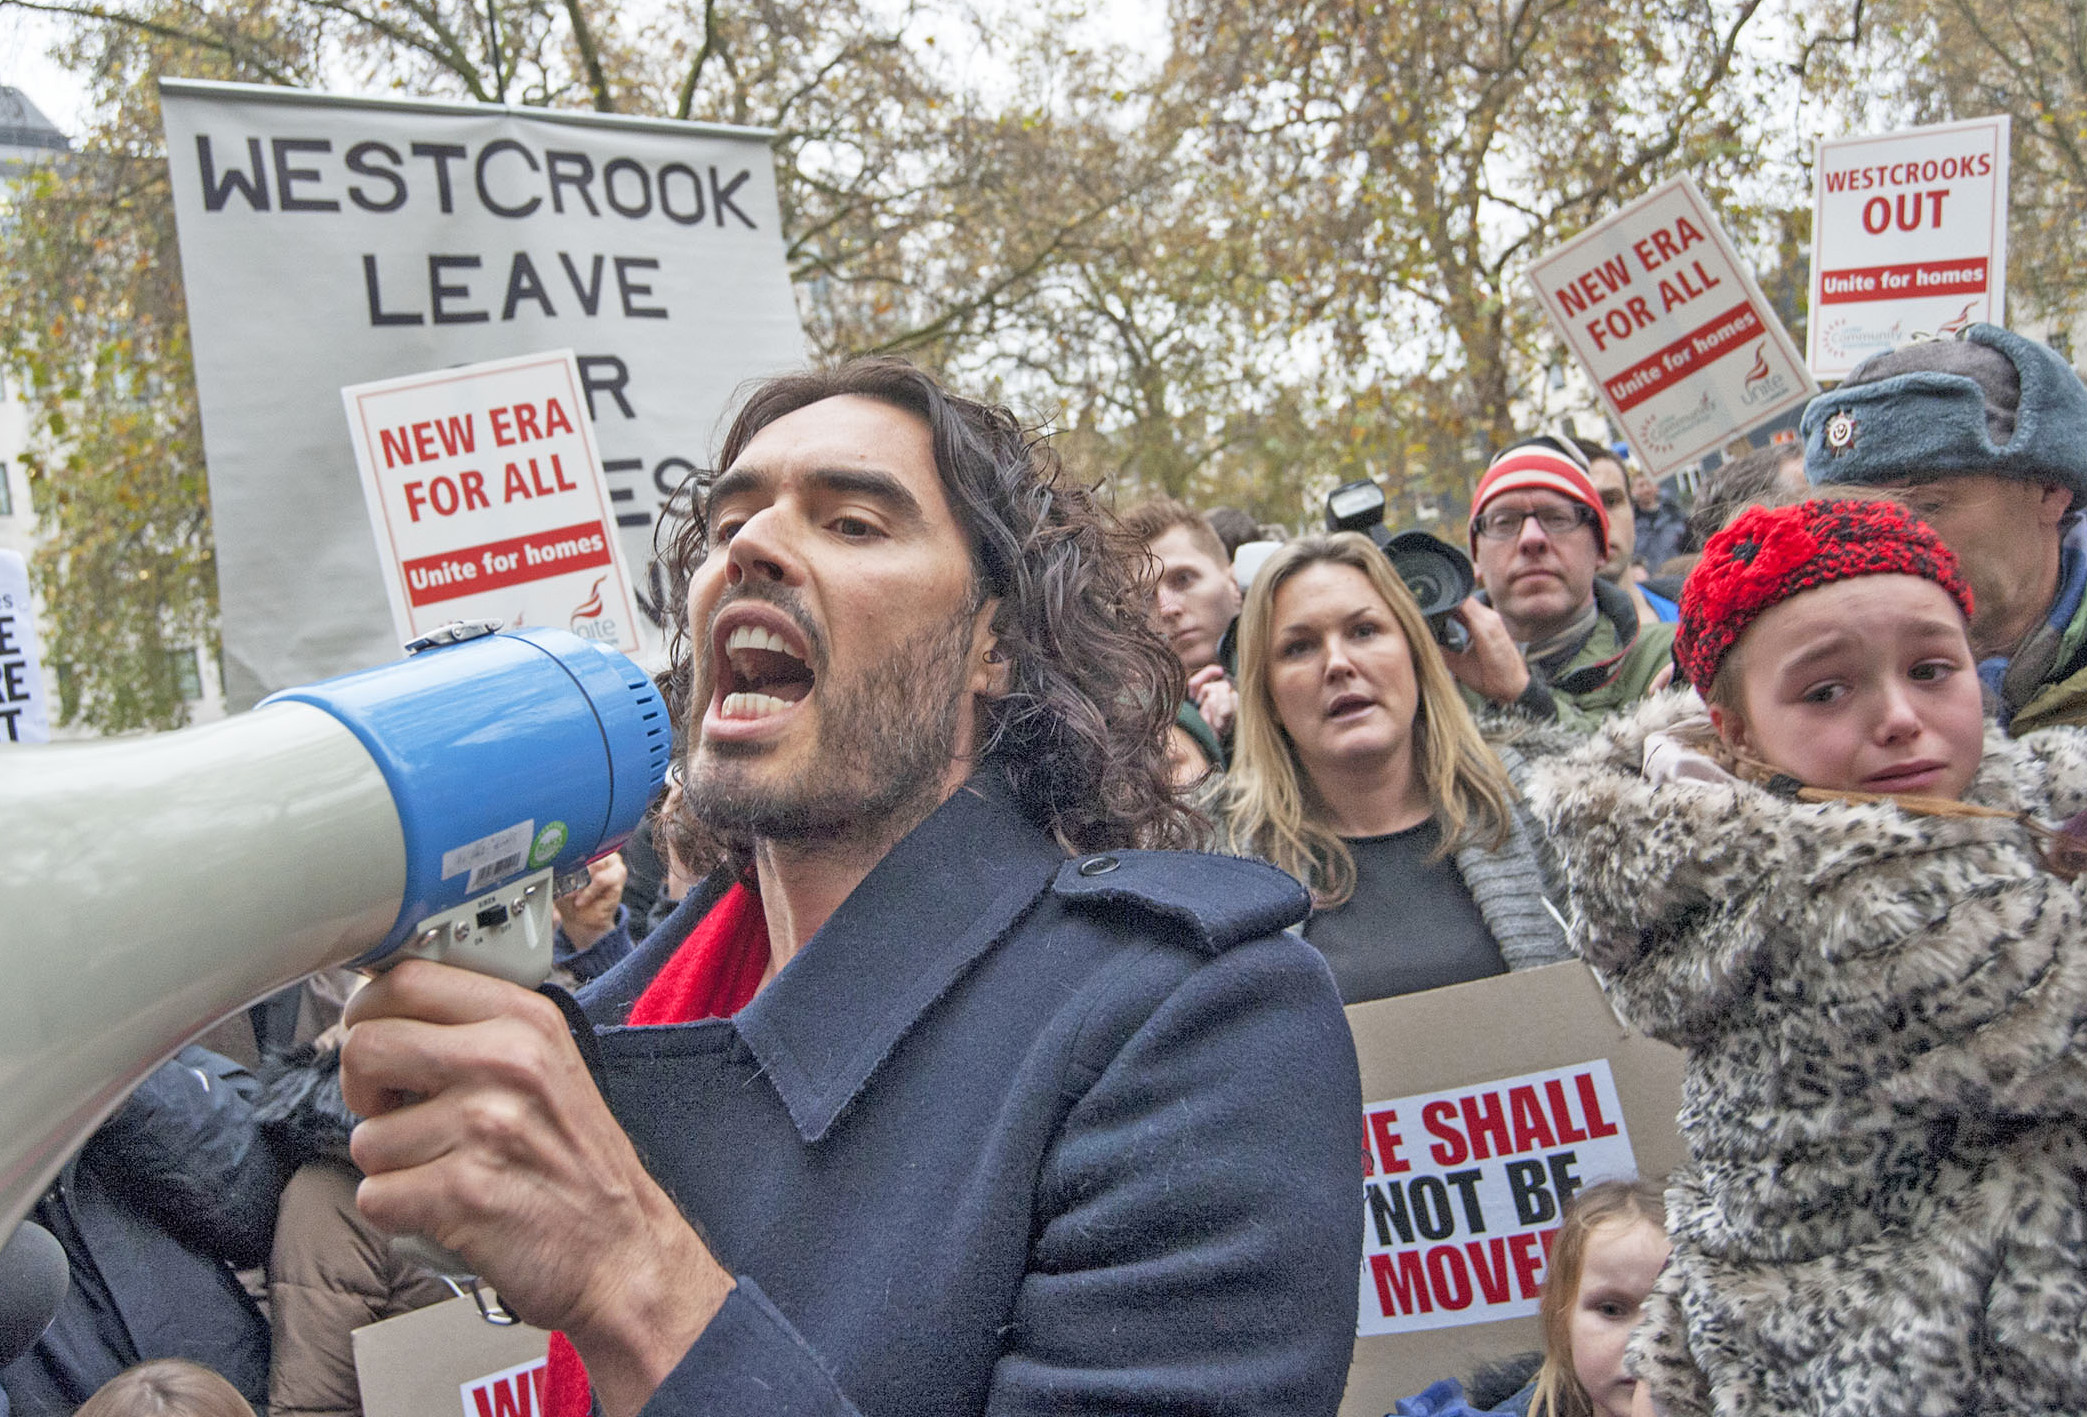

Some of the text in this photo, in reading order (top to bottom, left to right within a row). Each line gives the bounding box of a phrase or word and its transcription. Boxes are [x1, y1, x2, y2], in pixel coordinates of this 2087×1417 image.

[195, 134, 759, 230] WESTCROOK
[1825, 153, 1991, 193] WESTCROOKS
[1862, 189, 1950, 235] OUT
[361, 251, 670, 327] LEAVE
[1555, 216, 1705, 319] NEW ERA
[1586, 260, 1721, 352] FOR ALL
[1823, 266, 1984, 294] Unite for homes
[1610, 311, 1756, 401] Unite for homes
[379, 397, 575, 469] NEW ERA
[403, 453, 577, 523] FOR ALL
[409, 533, 604, 592] Unite for homes
[1422, 1072, 1618, 1166] SHALL
[1366, 1151, 1583, 1247] NOT BE
[1370, 1228, 1560, 1317] MOVE
